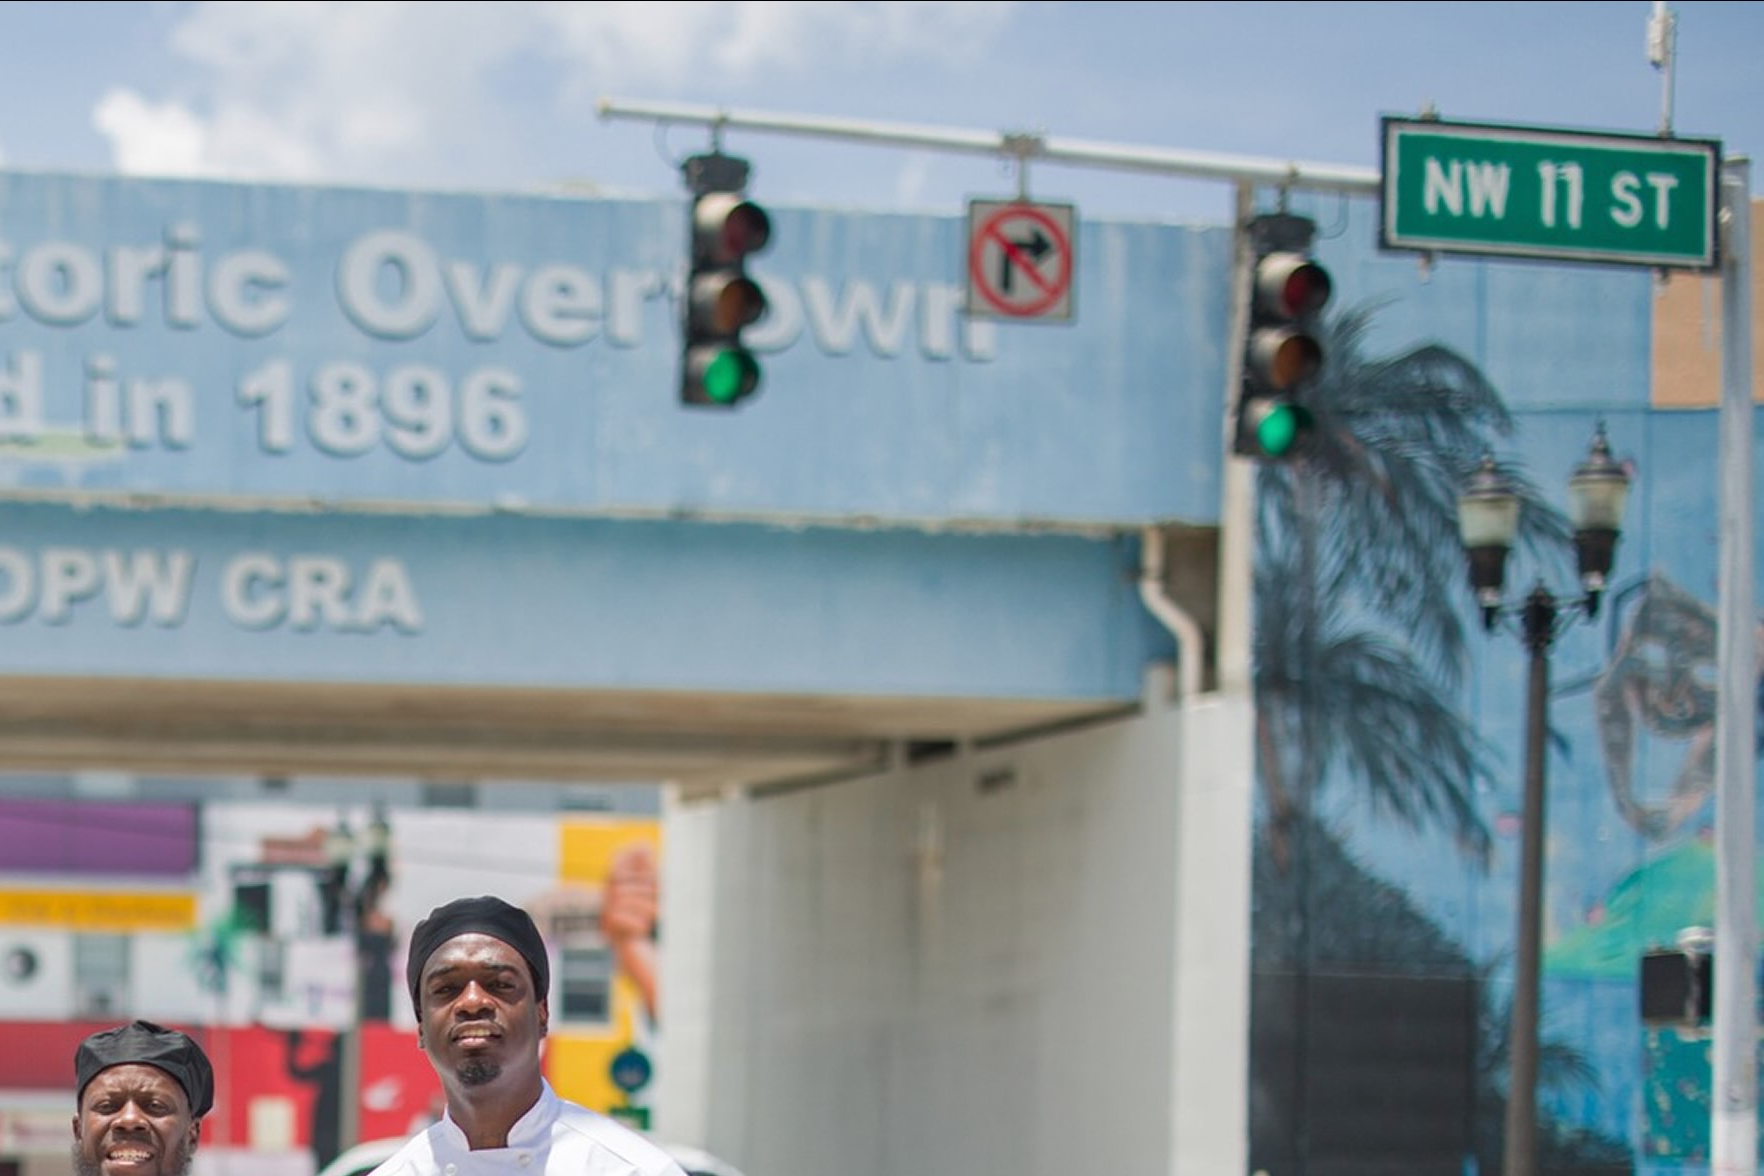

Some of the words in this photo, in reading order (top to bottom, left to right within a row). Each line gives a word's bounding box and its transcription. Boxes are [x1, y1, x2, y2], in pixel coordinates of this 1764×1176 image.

[1423, 156, 1511, 220] NW
[1538, 160, 1584, 230] 11
[1609, 170, 1678, 230] ST
[334, 227, 999, 363] Overown
[83, 354, 194, 451] in
[238, 357, 529, 463] 1896
[220, 550, 425, 636] CRA
